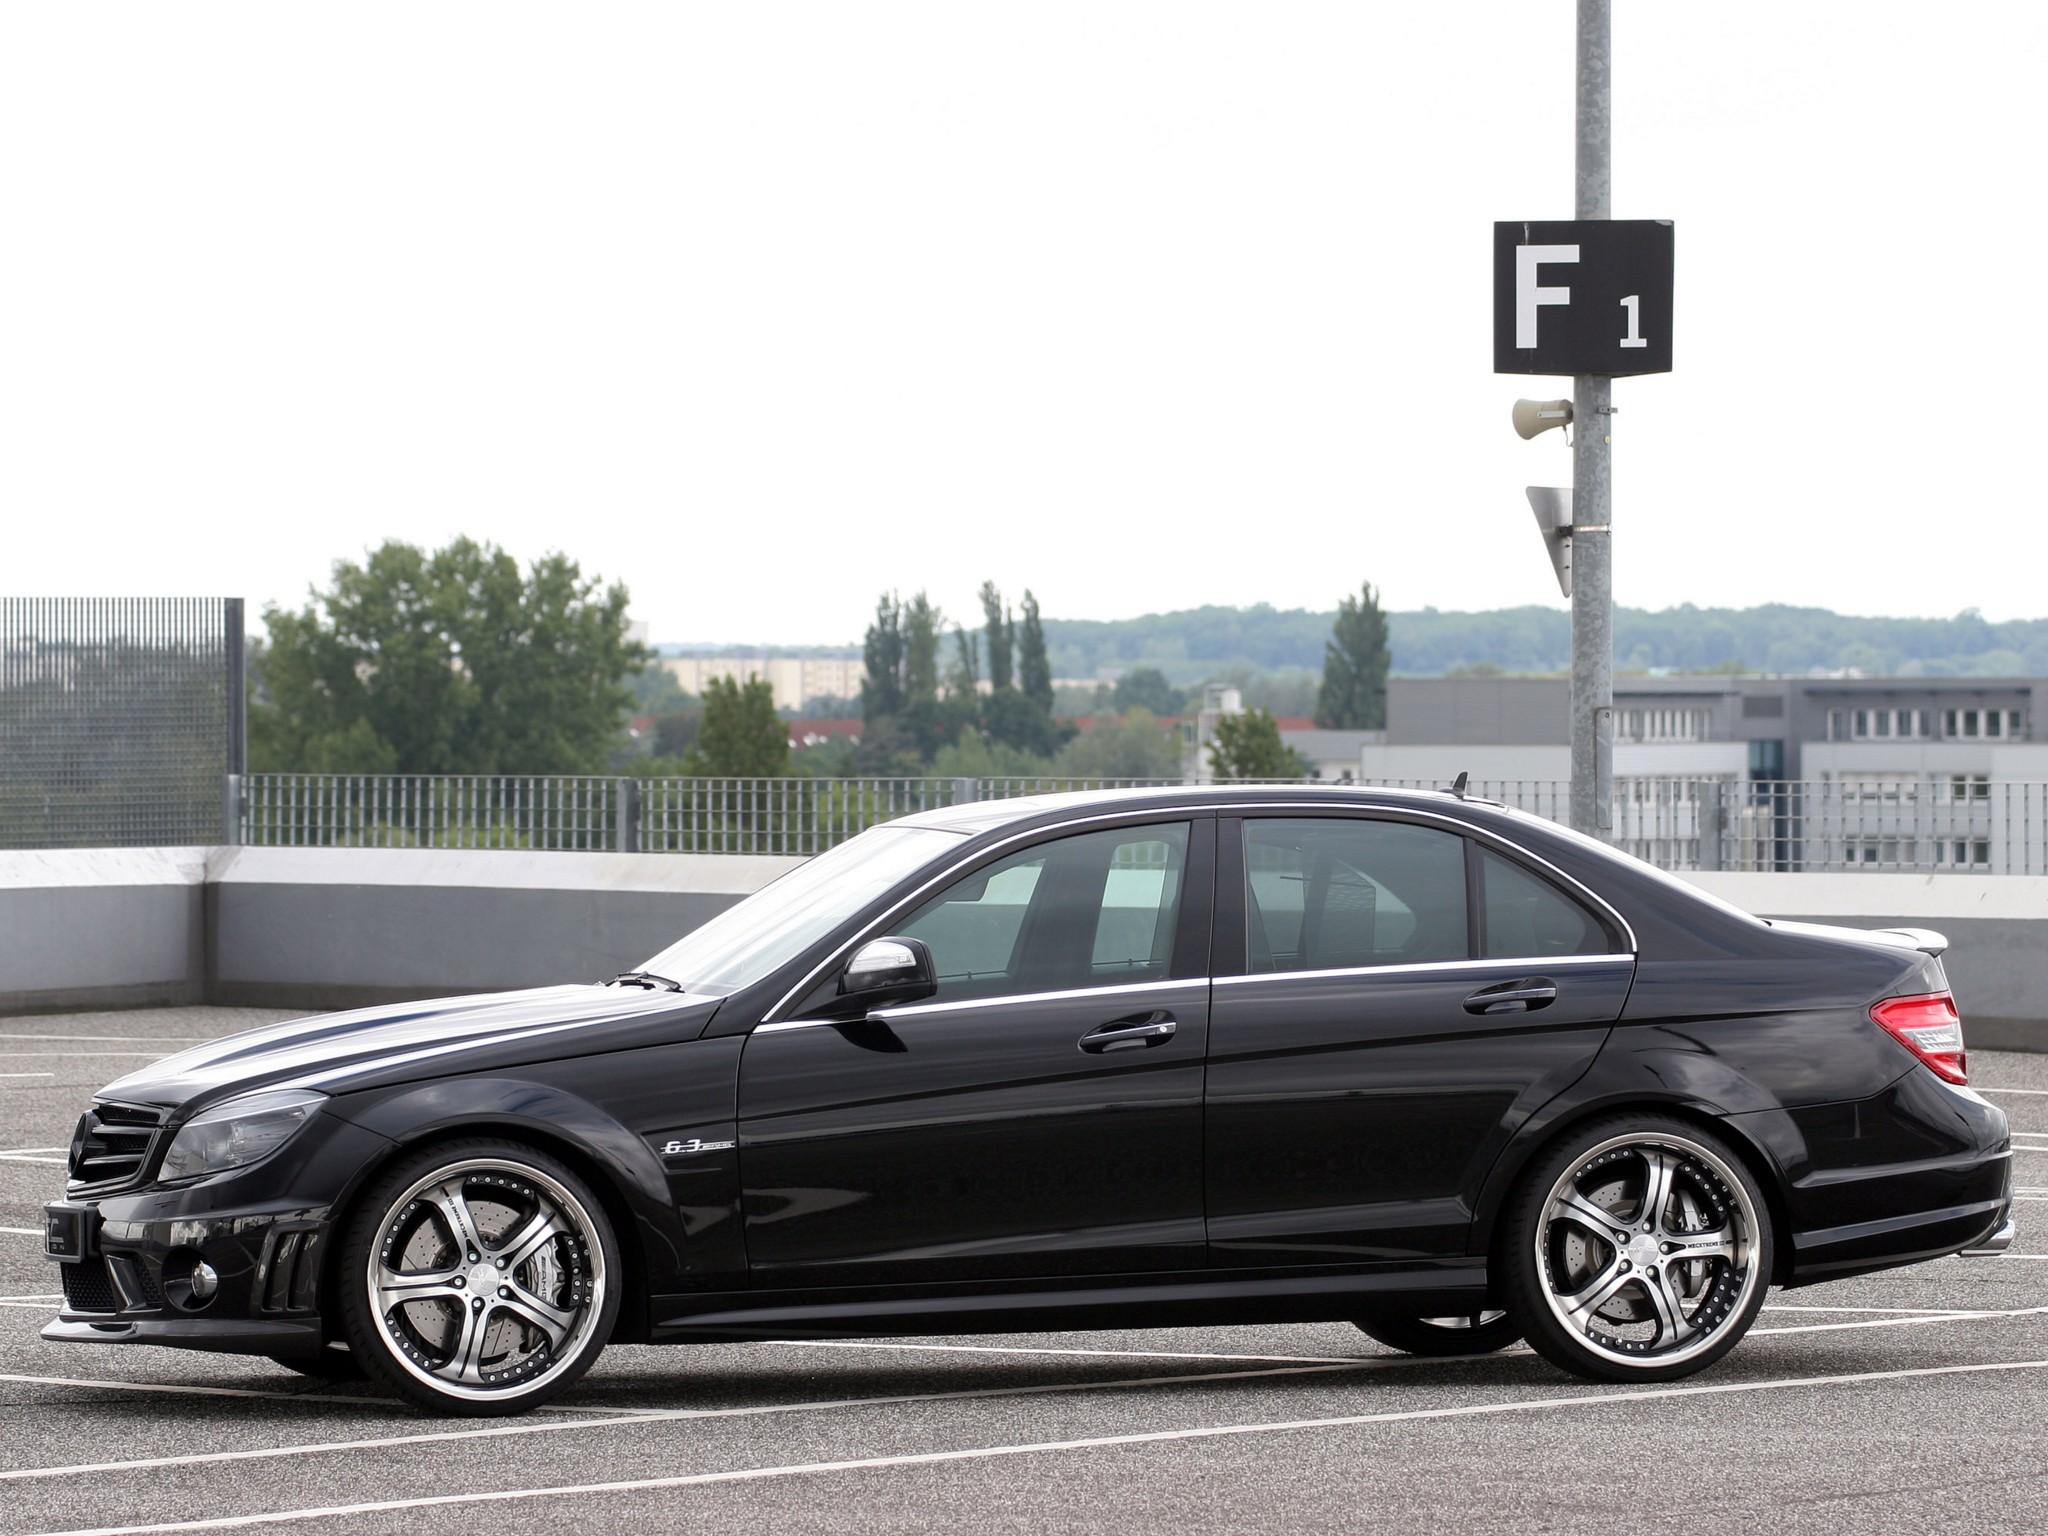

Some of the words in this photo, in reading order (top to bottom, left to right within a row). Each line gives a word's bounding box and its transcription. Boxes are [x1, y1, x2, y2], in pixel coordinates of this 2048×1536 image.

[1516, 245, 1580, 349] F
[1619, 295, 1647, 348] 1
[665, 1139, 701, 1154] 6.3
